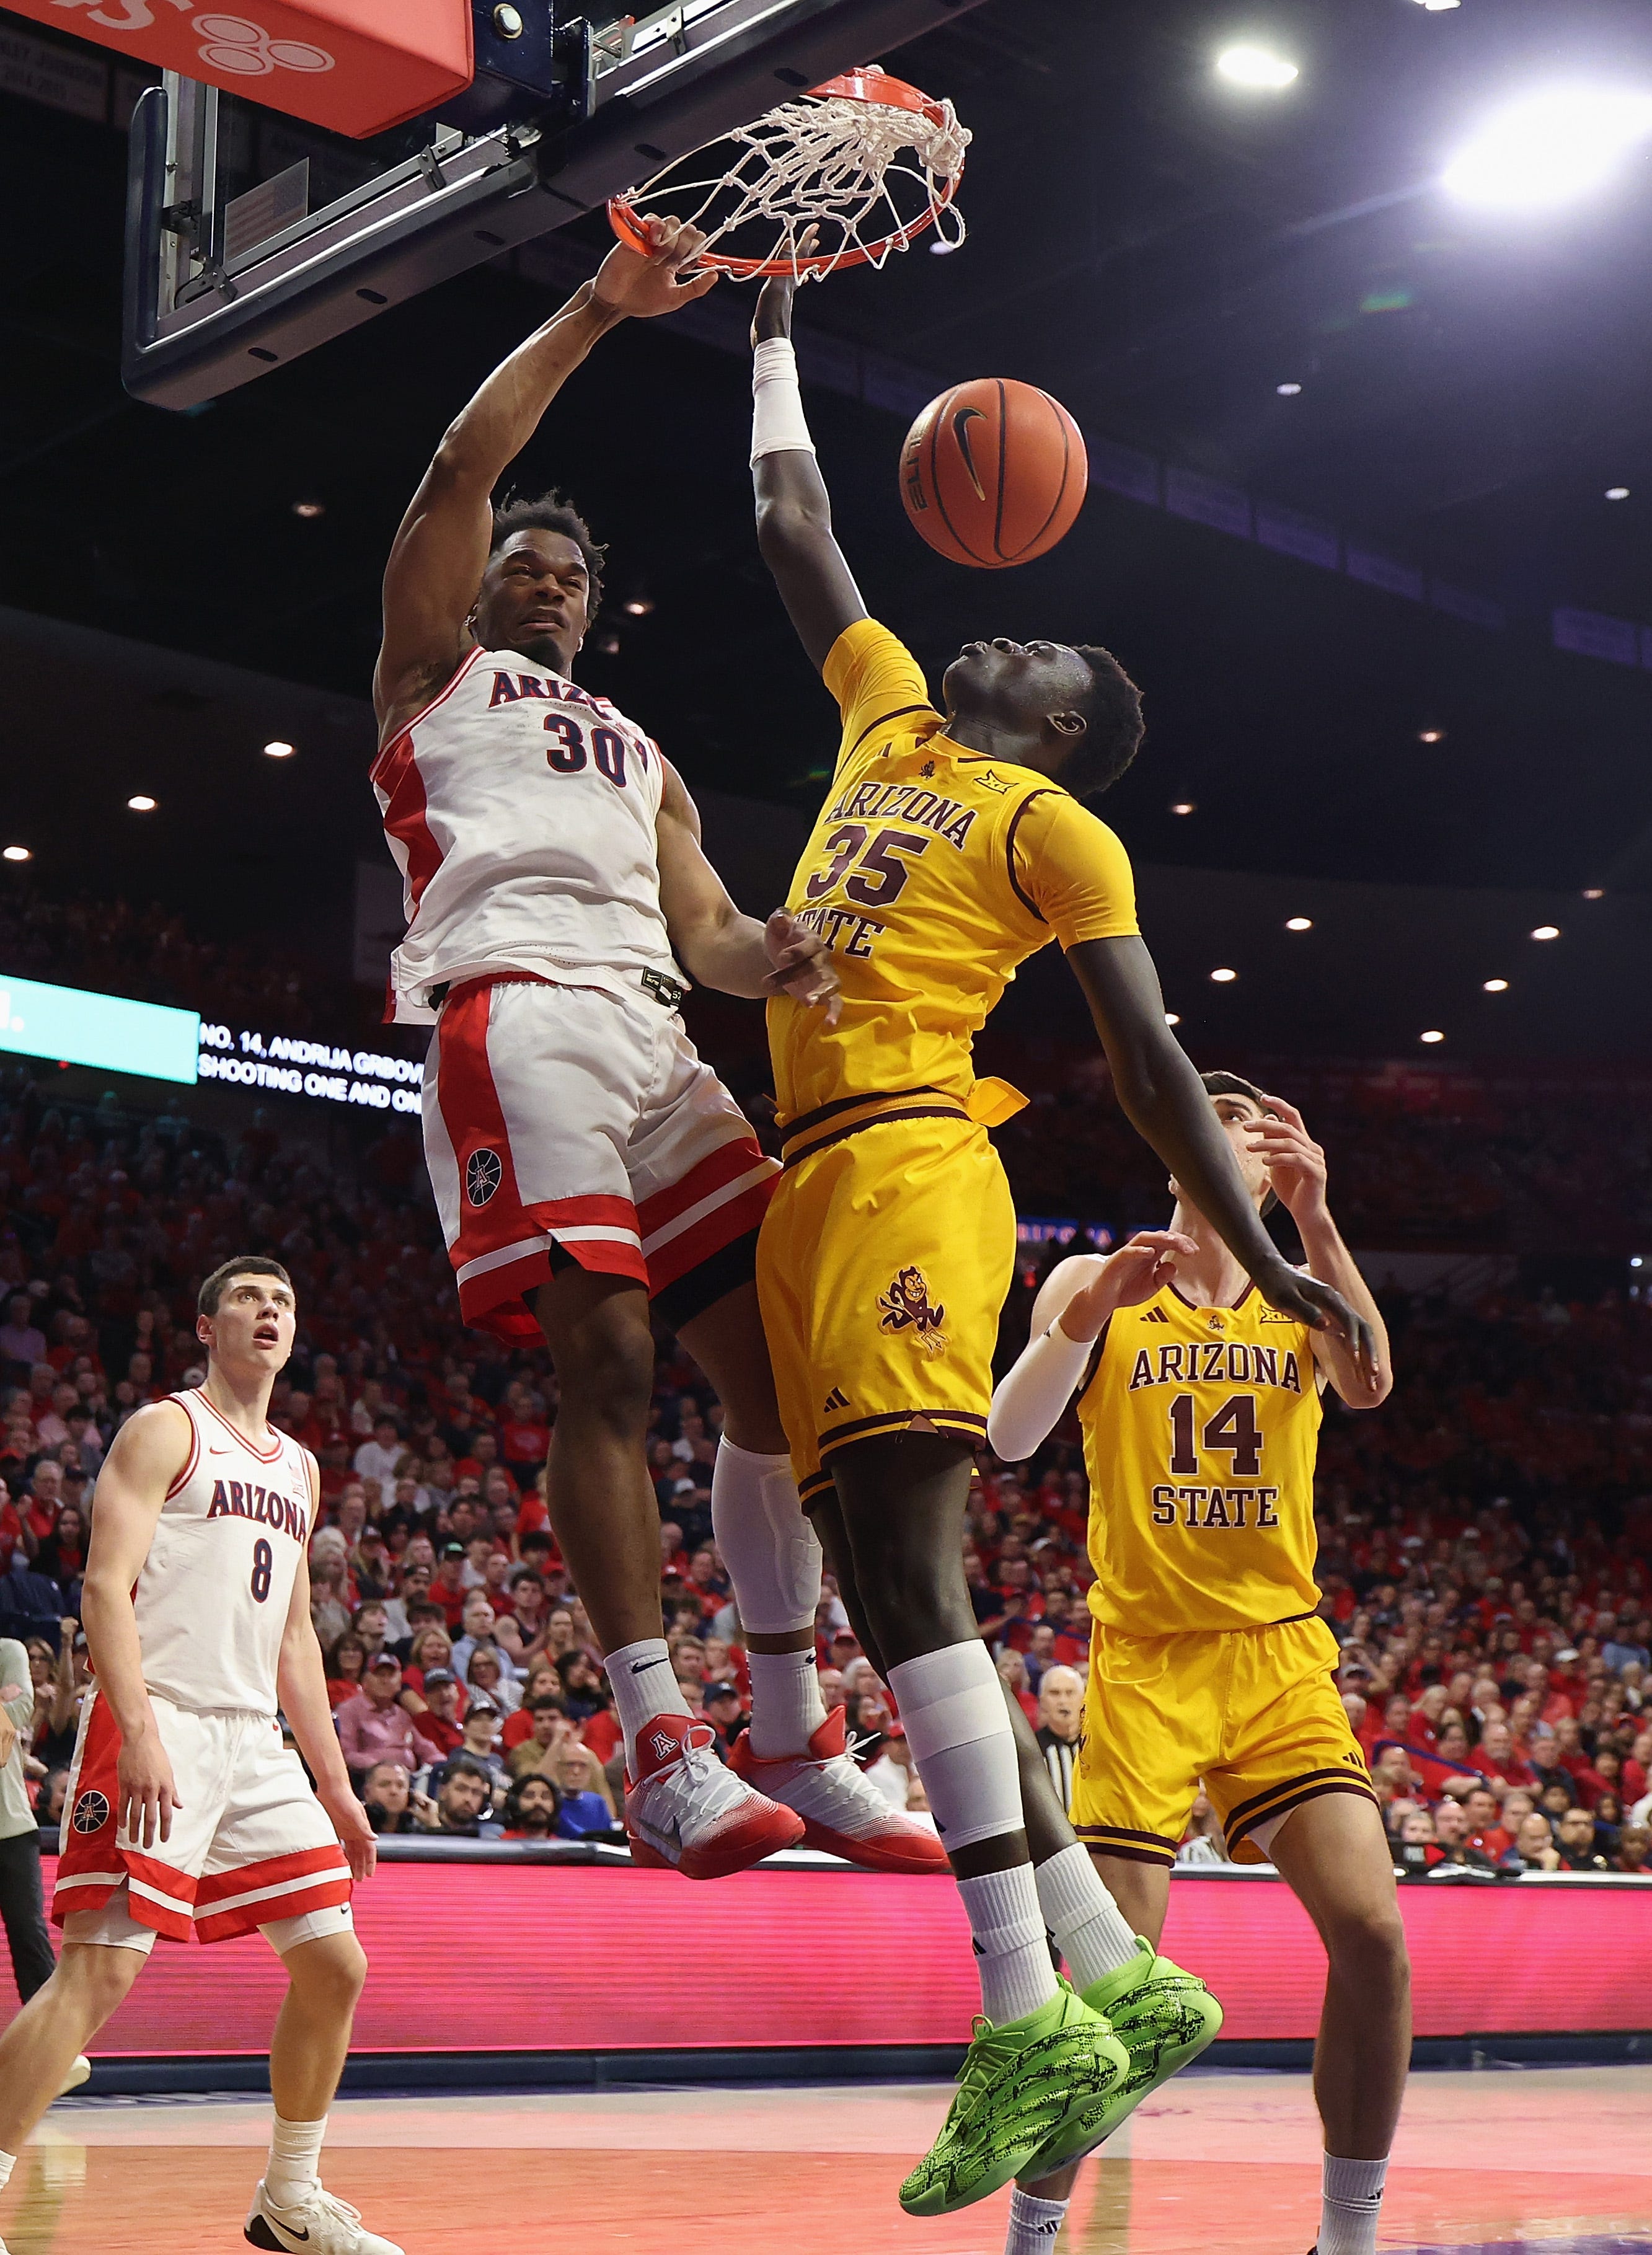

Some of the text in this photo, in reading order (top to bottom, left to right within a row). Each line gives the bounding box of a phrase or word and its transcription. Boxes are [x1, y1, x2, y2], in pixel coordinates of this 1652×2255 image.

[544, 713, 627, 788] 30
[823, 780, 979, 853] ARIZONA
[806, 823, 932, 909] 35
[199, 1022, 235, 1051] NO.
[239, 1030, 267, 1059] 14,
[268, 1035, 353, 1072] ANDRIJA
[197, 1052, 303, 1093] SHOOTING
[304, 1072, 348, 1102] ONE
[348, 1080, 391, 1109] AND
[1128, 1341, 1302, 1394] ARIZONA
[1167, 1393, 1265, 1477] 14
[206, 1480, 307, 1547] ARIZONA
[1151, 1484, 1279, 1528] STATE
[250, 1538, 273, 1604] 8
[649, 1728, 680, 1761] A
